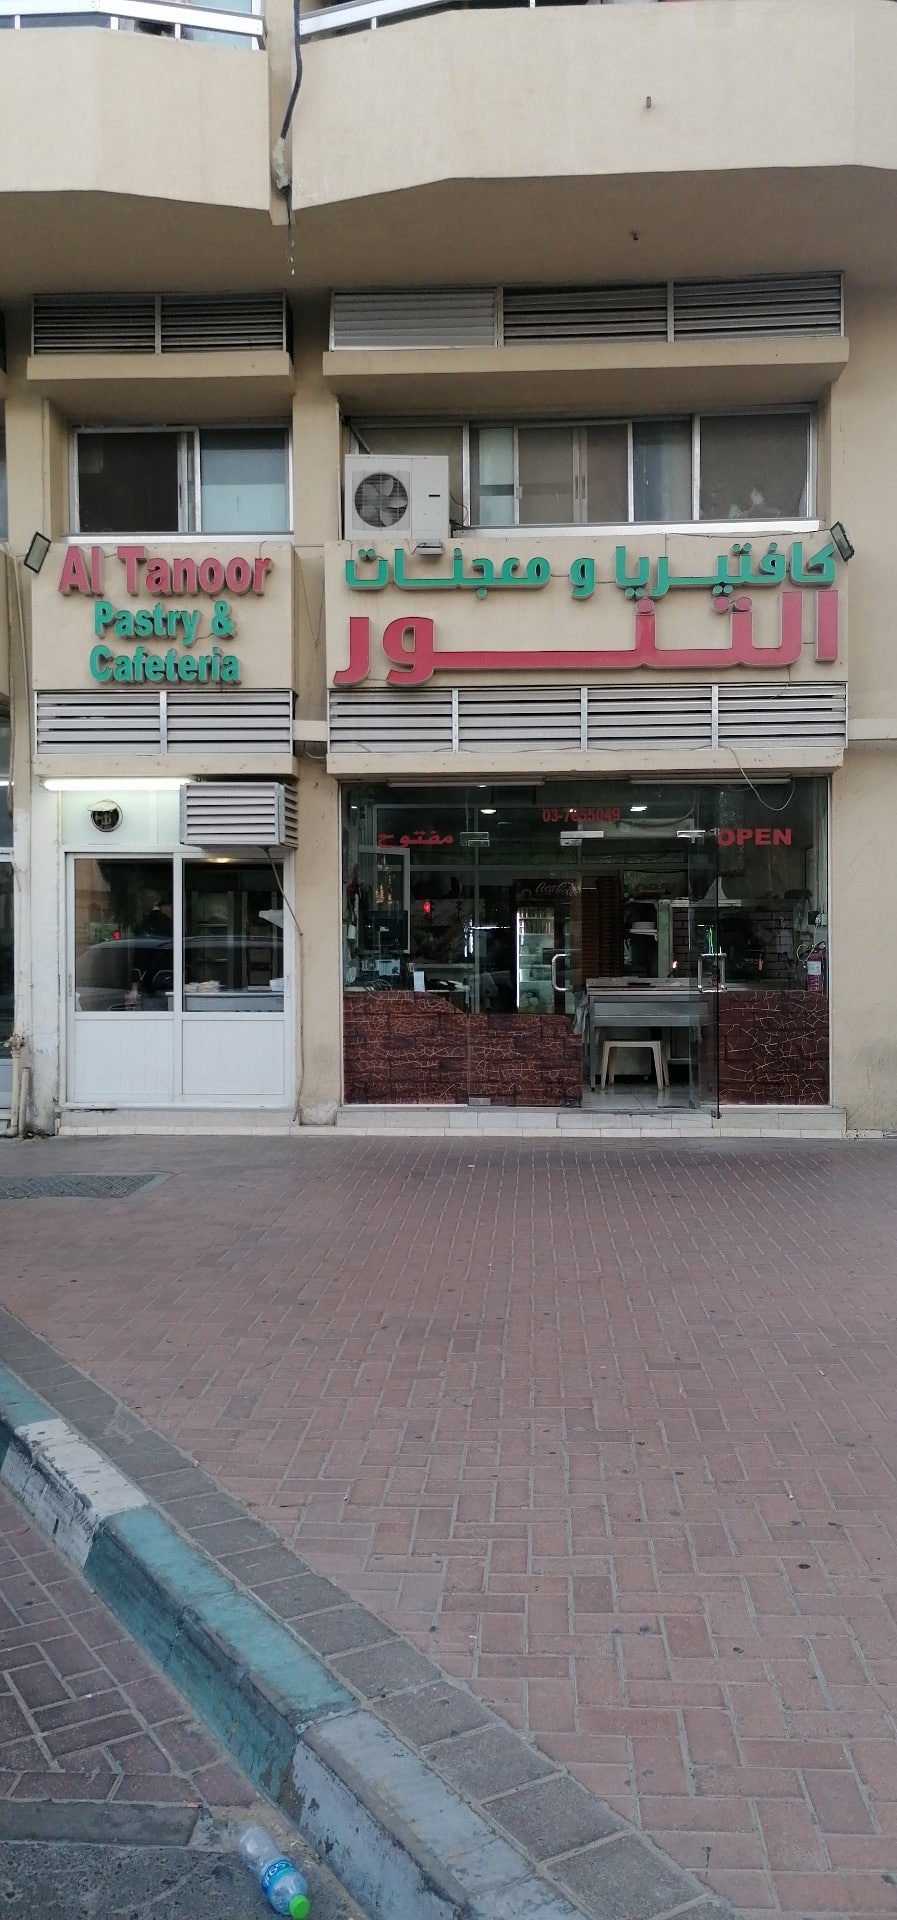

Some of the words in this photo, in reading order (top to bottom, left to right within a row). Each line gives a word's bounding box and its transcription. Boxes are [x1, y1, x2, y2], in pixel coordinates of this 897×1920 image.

[58, 546, 103, 595] Al
[117, 546, 273, 595] Tanoor
[345, 547, 551, 600] معجنات
[570, 558, 595, 599] و
[615, 542, 836, 599] كافتيريا
[94, 600, 199, 647] Pastry
[211, 600, 235, 638] &
[333, 590, 838, 686] التنور
[89, 644, 241, 684] Cafeteria
[378, 830, 454, 848] مفتوح
[717, 828, 792, 846] OPEN
